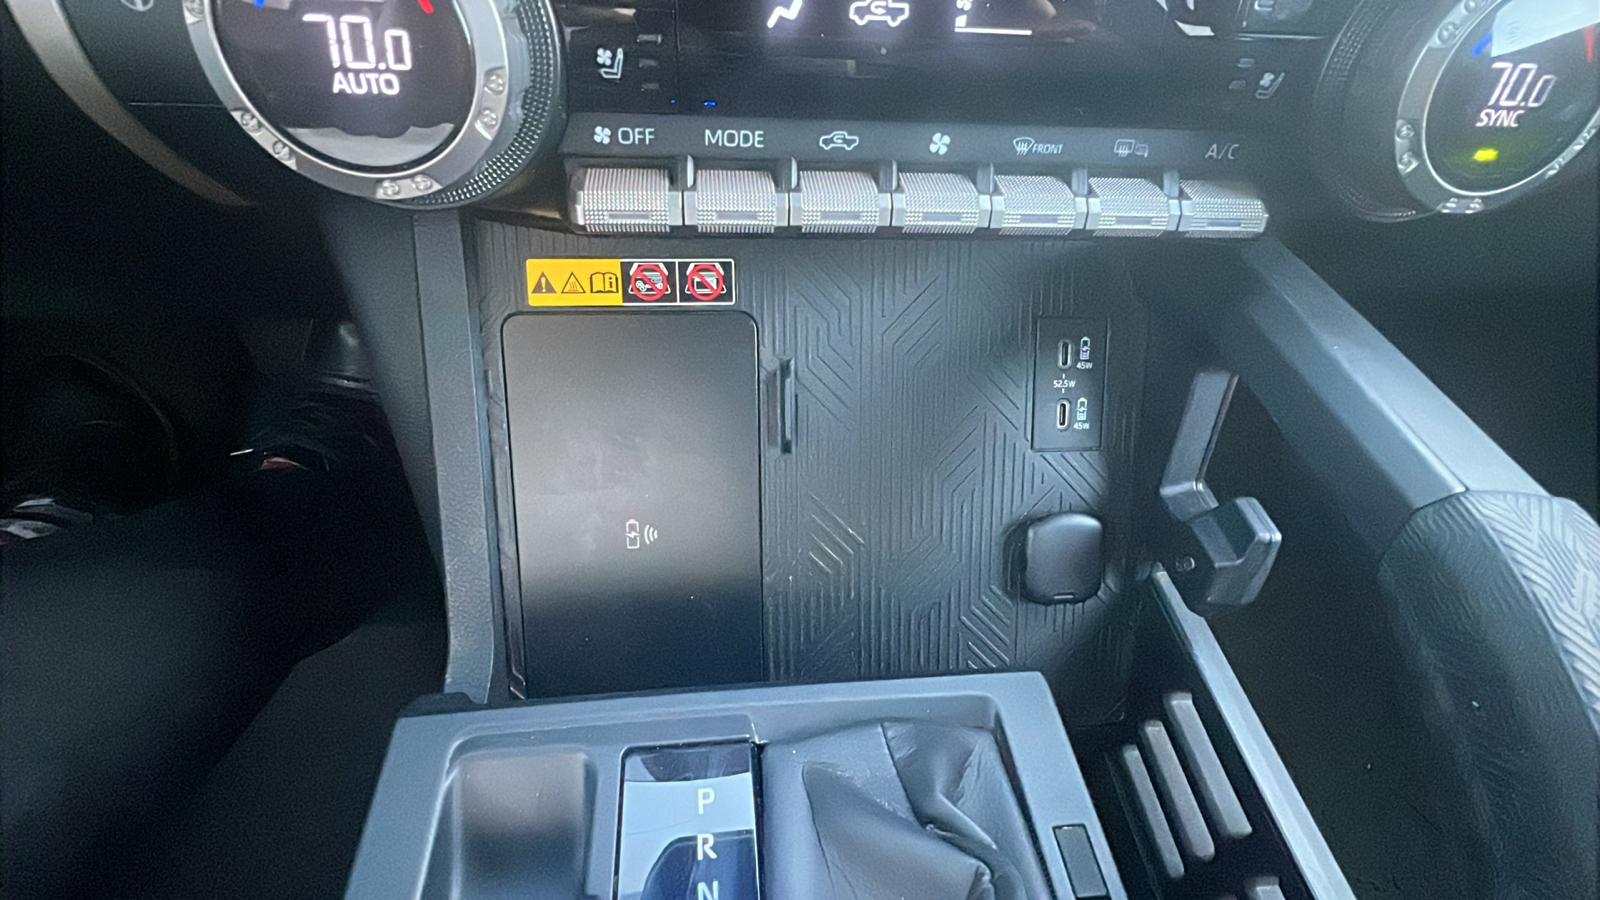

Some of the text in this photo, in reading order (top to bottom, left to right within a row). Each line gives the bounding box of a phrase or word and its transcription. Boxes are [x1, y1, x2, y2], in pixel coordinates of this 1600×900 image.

[303, 14, 412, 70] 70.0
[333, 73, 399, 94] AUTO
[1488, 62, 1557, 107] 70.0
[1475, 109, 1525, 127] SYNC
[618, 128, 655, 145] OFF
[705, 130, 764, 148] MODE
[1032, 143, 1063, 155] FRONT
[1205, 143, 1240, 160] A/C
[1076, 361, 1093, 369] 45W
[1053, 380, 1076, 388] 52.5W
[1073, 422, 1090, 430] 45W
[697, 787, 715, 815] P
[697, 833, 717, 861] R
[697, 880, 719, 900] N
